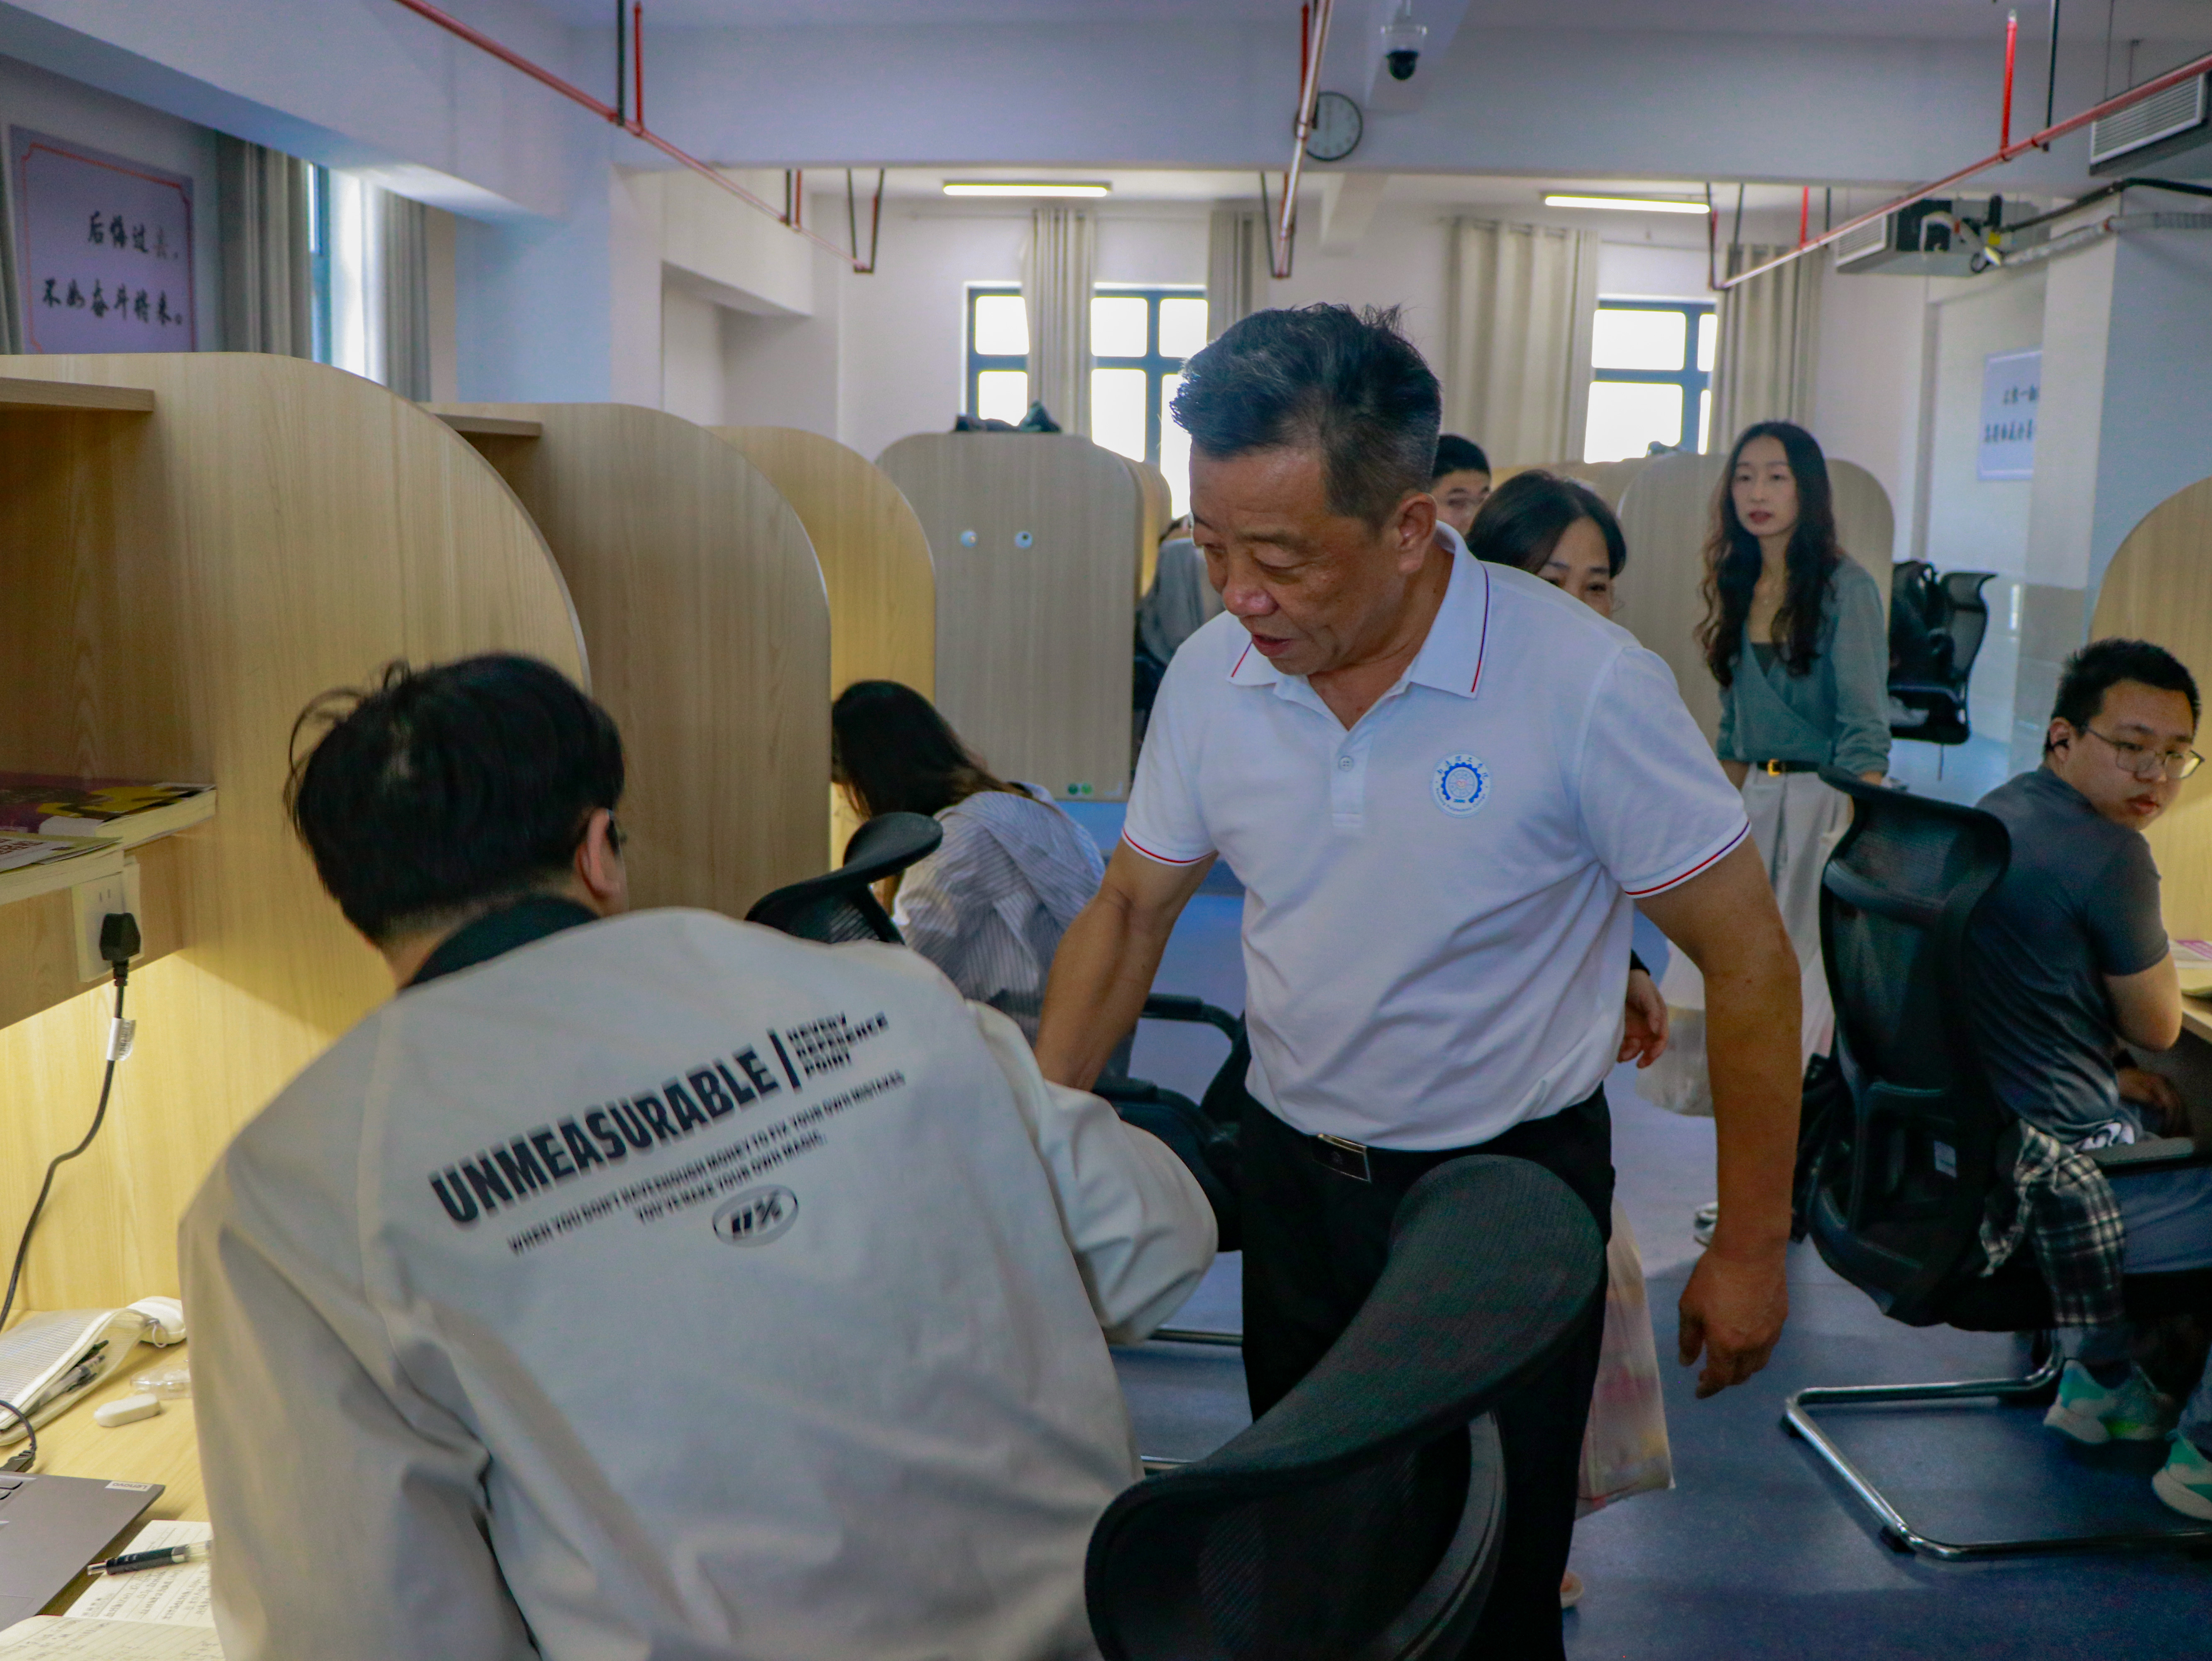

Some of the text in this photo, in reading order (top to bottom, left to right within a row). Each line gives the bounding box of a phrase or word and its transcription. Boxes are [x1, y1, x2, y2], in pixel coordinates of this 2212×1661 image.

[795, 1012, 888, 1060] REFERENCE
[803, 1049, 852, 1079] POINT
[428, 1044, 781, 1231] UNMEASURABLE
[551, 1210, 581, 1232] YOU
[705, 1140, 751, 1171] MONEY
[750, 1132, 768, 1149] TO
[768, 1122, 790, 1140] FIX
[788, 1106, 823, 1129] YOUR
[823, 1094, 852, 1114] OWN
[715, 1166, 751, 1191] YOUR
[751, 1149, 783, 1174] OWN
